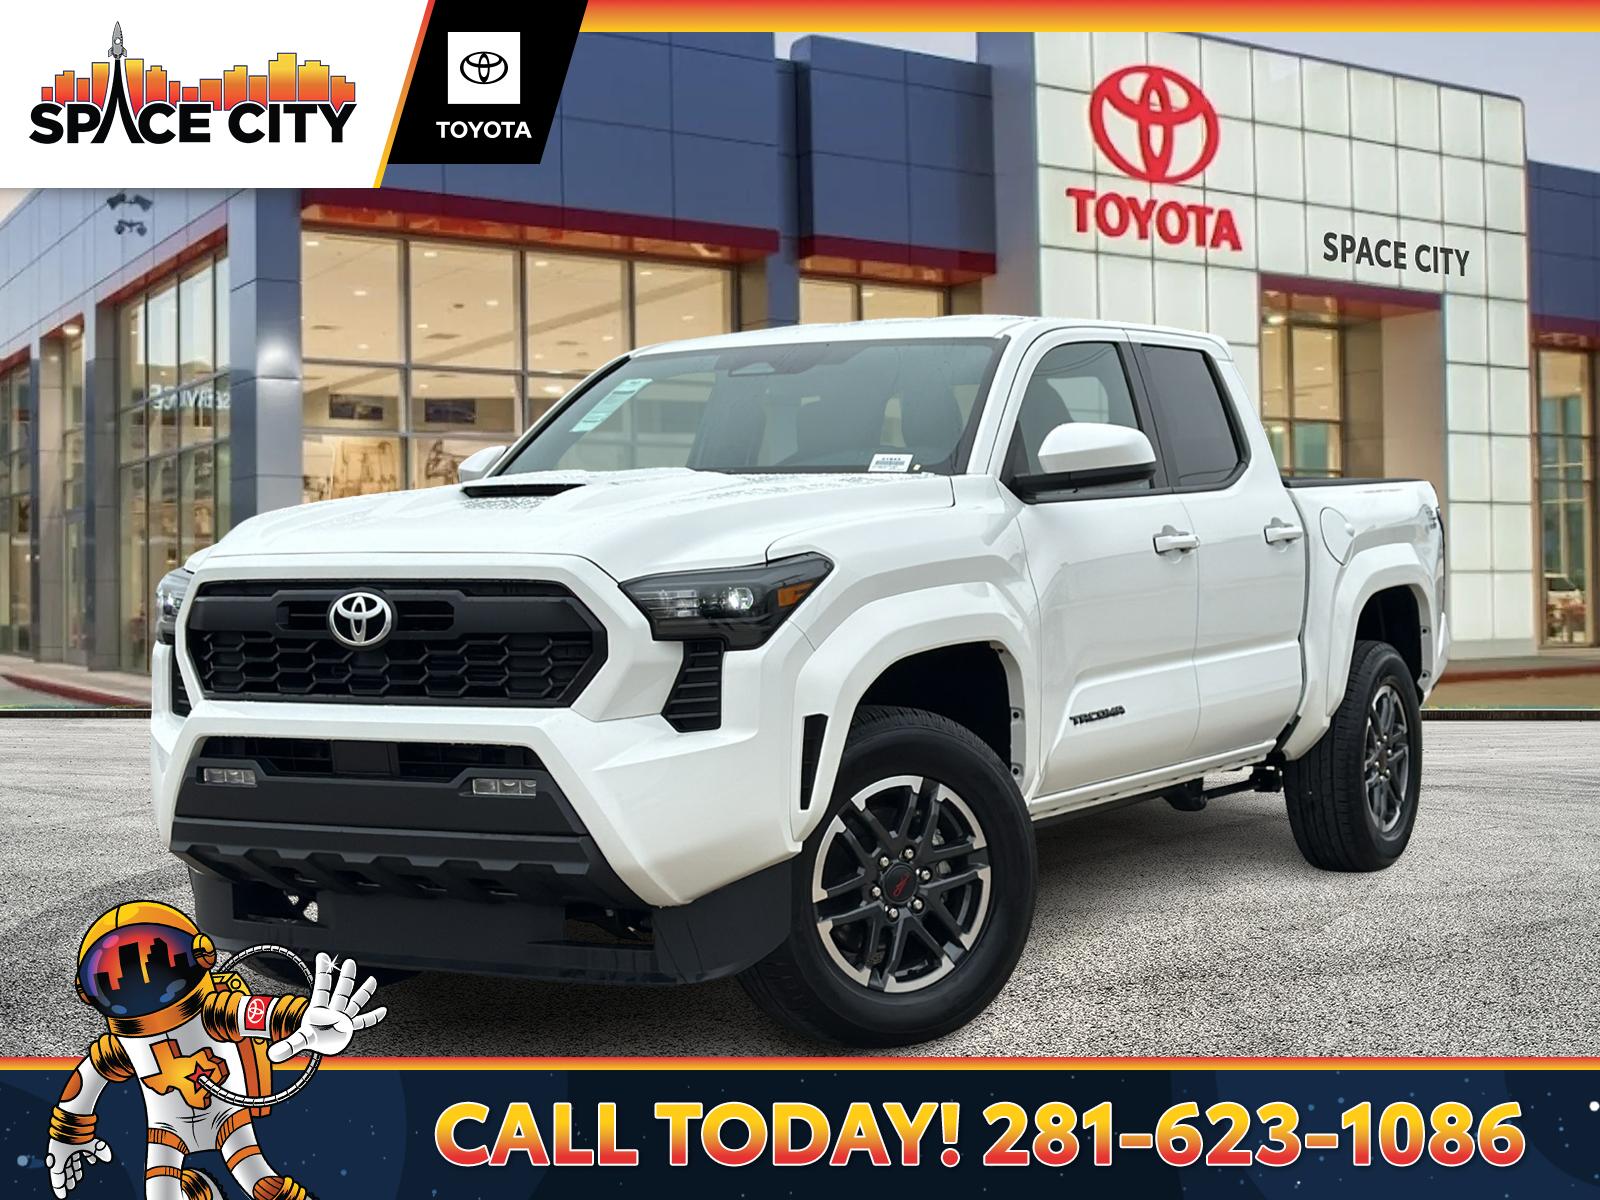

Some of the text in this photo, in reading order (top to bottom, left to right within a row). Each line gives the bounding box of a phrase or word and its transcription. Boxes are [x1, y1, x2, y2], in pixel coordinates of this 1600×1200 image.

[1066, 187, 1242, 251] TOYOTA
[1323, 232, 1470, 277] SPACE CITY
[1069, 705, 1125, 726] TACOMA
